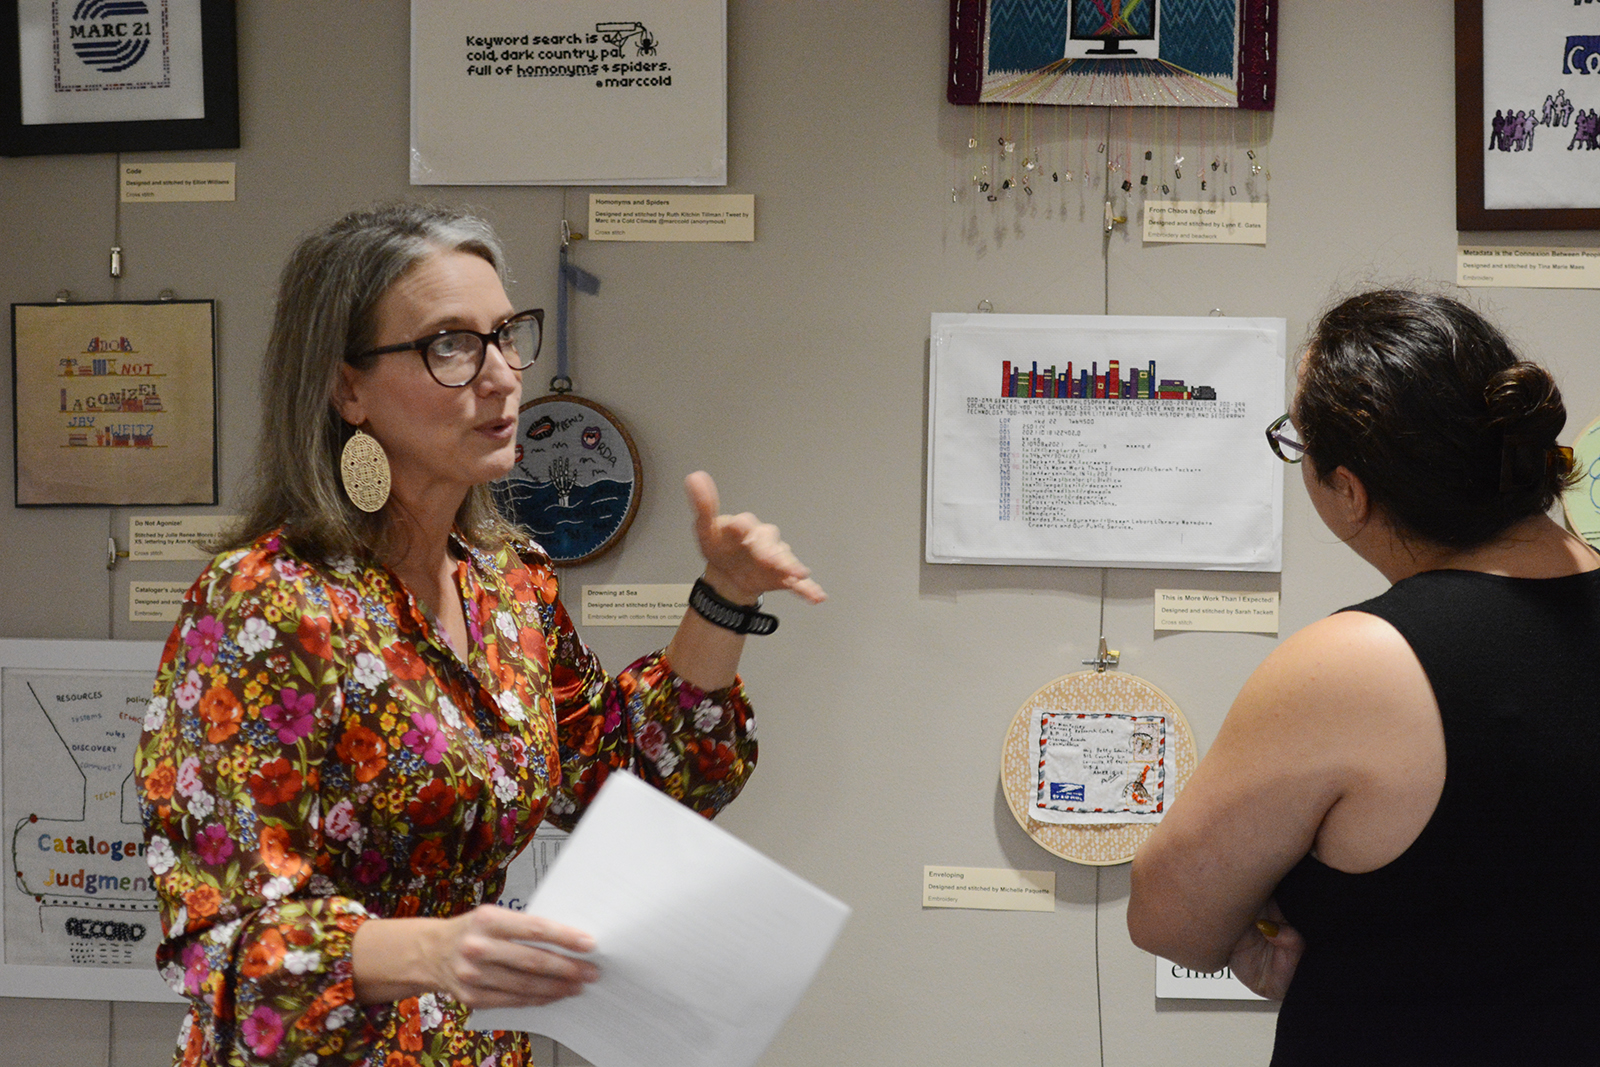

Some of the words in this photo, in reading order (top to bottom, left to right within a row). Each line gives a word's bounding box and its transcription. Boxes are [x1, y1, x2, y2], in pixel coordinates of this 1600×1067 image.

[69, 23, 128, 39] MARC
[133, 22, 152, 37] 21
[466, 34, 529, 49] Keyword
[532, 33, 582, 45] search
[585, 33, 598, 44] is
[602, 34, 612, 44] a
[466, 50, 498, 62] cold,
[501, 49, 534, 61] dark
[538, 49, 598, 62] country,
[466, 64, 492, 76] full
[494, 64, 513, 75] of
[516, 64, 599, 77] homonyms
[612, 61, 672, 75] spiders.
[121, 363, 153, 375] NOT
[68, 416, 96, 428] JAY
[596, 442, 618, 468] RDA
[56, 691, 103, 703] RESOURCES
[105, 730, 126, 739] rules
[71, 744, 117, 753] DISCOVERY
[38, 833, 146, 862] Cataloger
[43, 868, 157, 894] Judgment
[928, 871, 964, 879] Enveloping
[64, 917, 146, 942] RECORD
